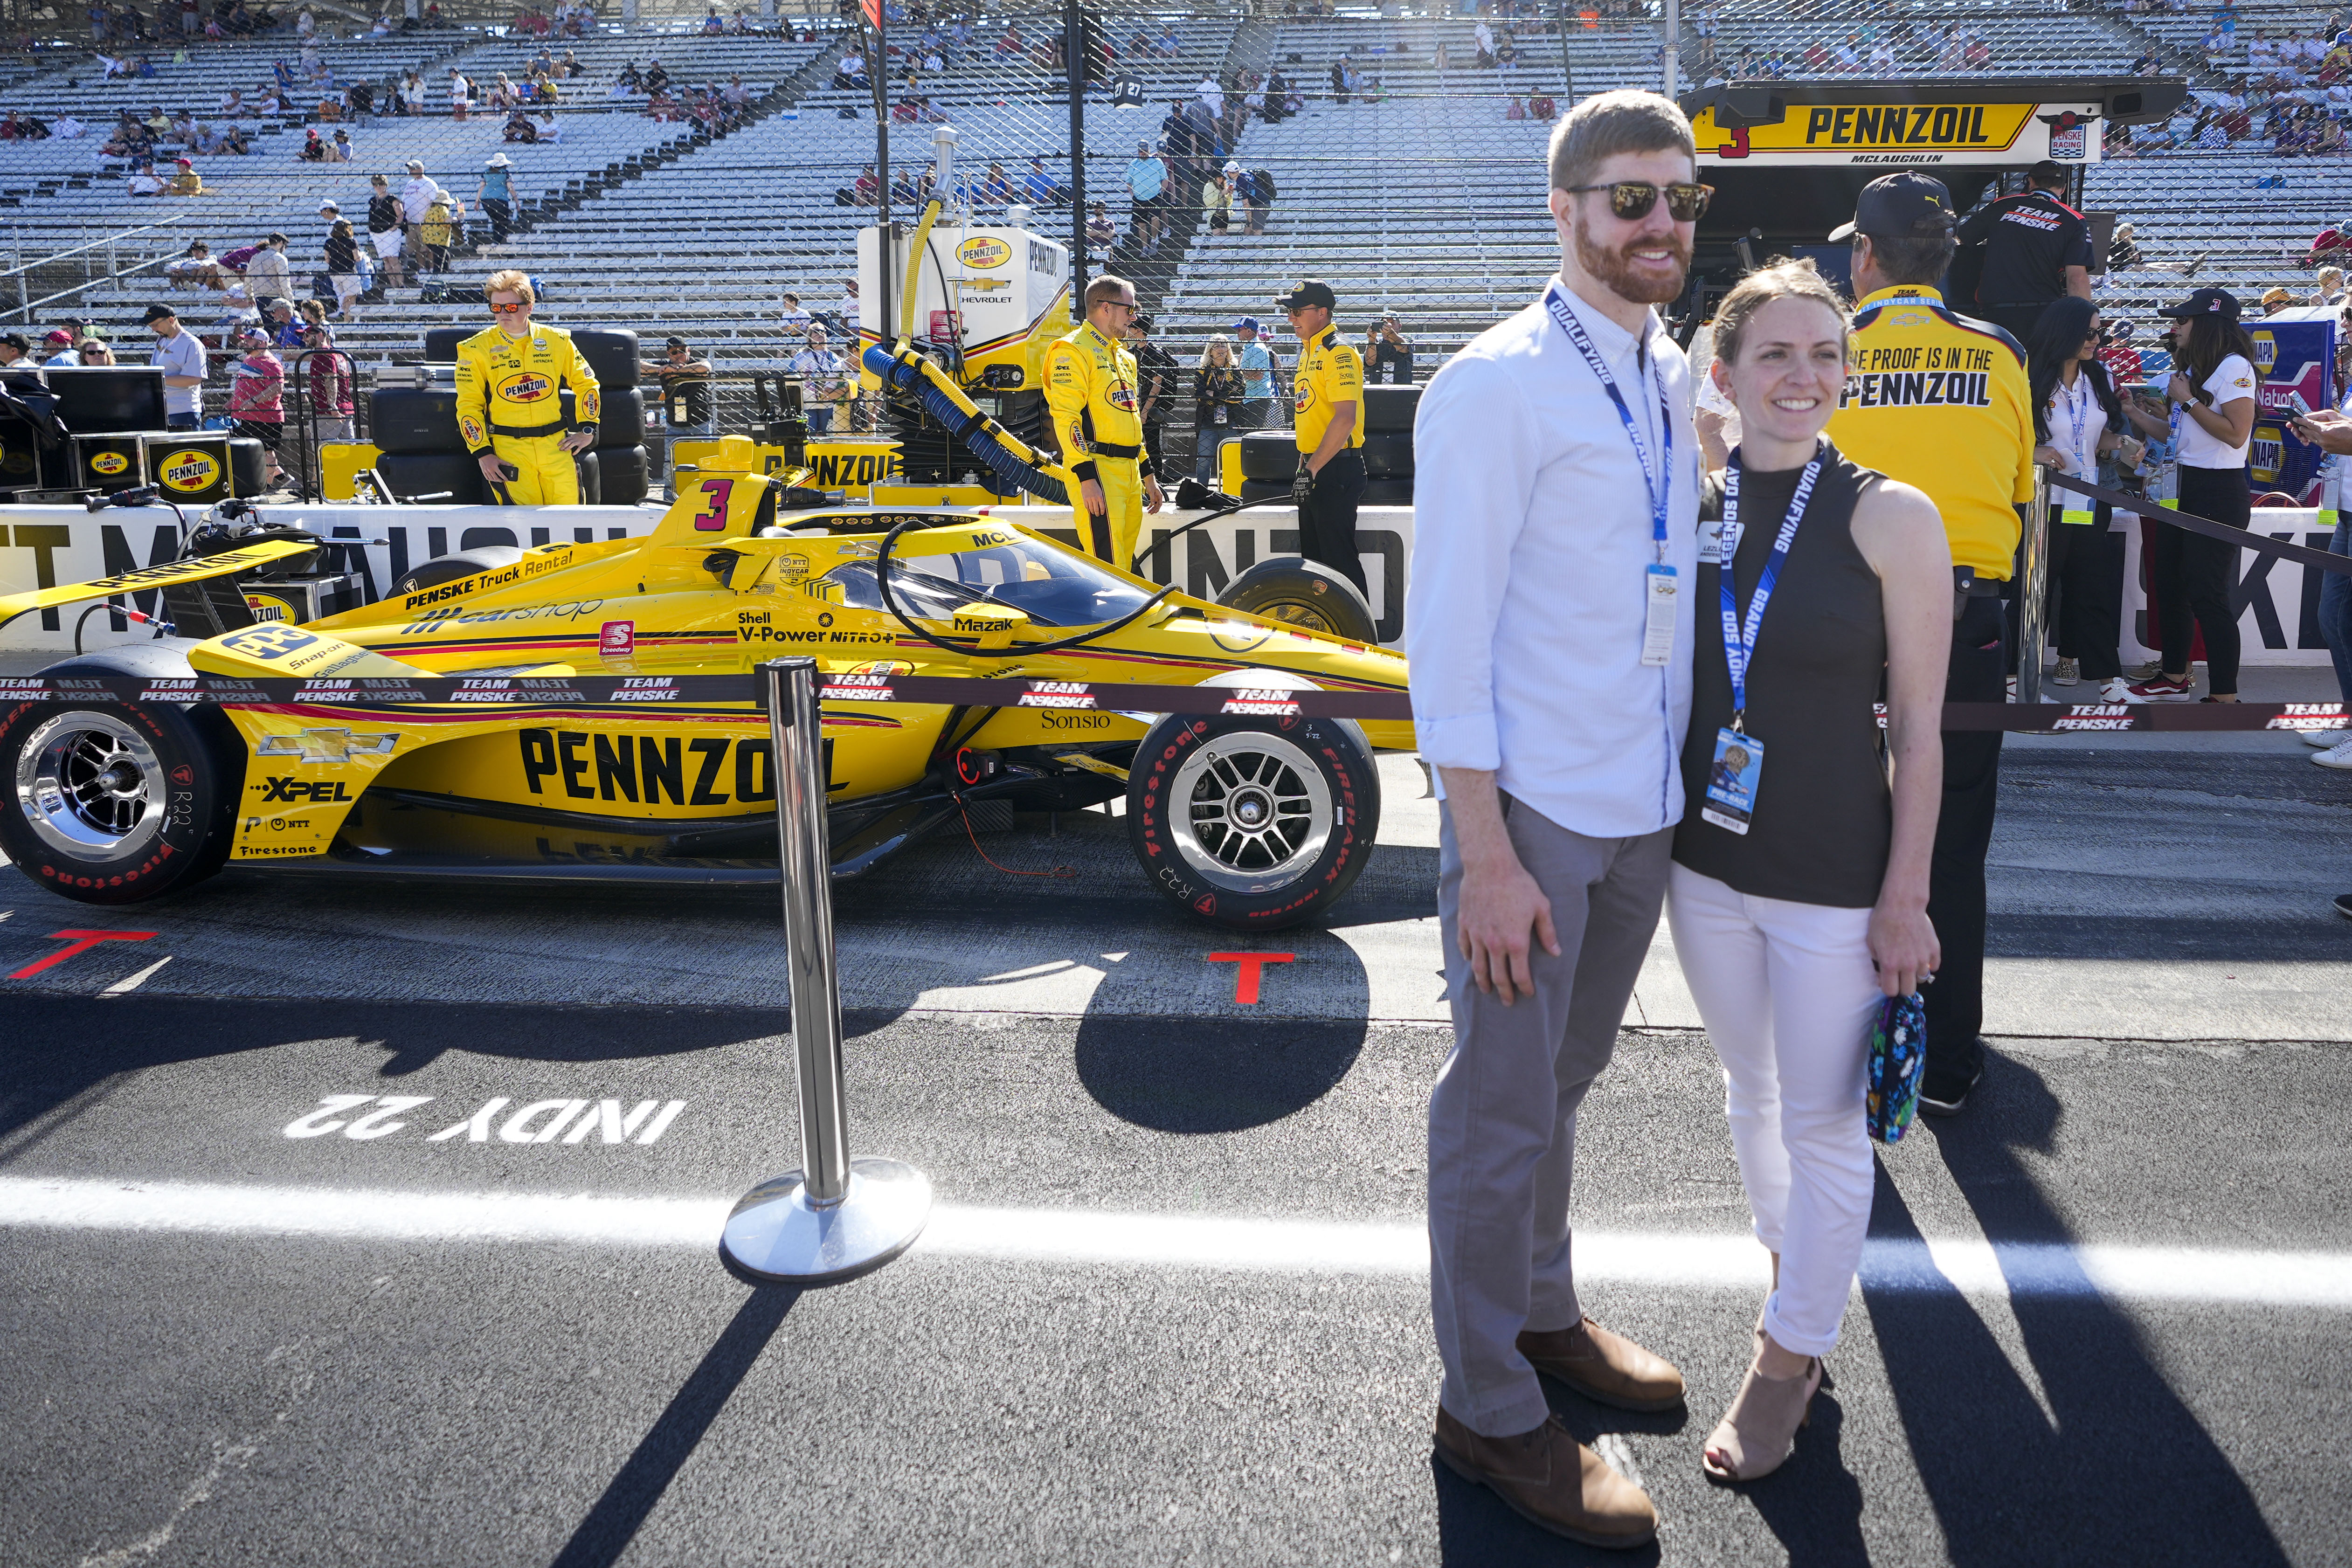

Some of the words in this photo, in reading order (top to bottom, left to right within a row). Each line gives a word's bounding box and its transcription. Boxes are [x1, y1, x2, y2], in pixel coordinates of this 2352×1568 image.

[1114, 82, 1123, 98] 27
[1128, 82, 1141, 97] 27
[1806, 107, 1988, 144] PENNZOIL
[1719, 127, 1750, 159] 3
[2053, 131, 2082, 140] PENSKE
[1850, 154, 1944, 163] MCLAUGHLIN
[1999, 212, 2060, 231] PENSKE
[2015, 205, 2060, 220] TEAM
[963, 244, 1004, 259] PENNZOIL
[1030, 240, 1058, 278] PENNZOIL
[1873, 298, 1916, 307] INDYCAR
[1089, 330, 1109, 348] PENNZOIL
[1550, 299, 1613, 385] QUALIFYING
[1871, 348, 1922, 370] PROOF
[1926, 348, 1942, 368] IS
[1946, 348, 1963, 368] IN
[1966, 349, 1994, 369] THE
[505, 379, 547, 397] PENNZOIL
[1839, 372, 1992, 408] PENNZOIL
[464, 420, 479, 442] PENNZOIL
[1072, 425, 1088, 453] PENNZOIL
[96, 459, 122, 469] PENNZOIL
[168, 462, 211, 480] PENNZOIL
[1726, 466, 1741, 496] DAY
[694, 479, 734, 532] 3
[1774, 461, 1821, 554] QUALIFYING
[1721, 499, 1739, 570] LEGENDS
[84, 552, 273, 588] PENNZOIL
[405, 580, 473, 610] PENSKE
[479, 566, 520, 589] Truck
[524, 550, 573, 577] Rental
[458, 598, 603, 624] carshop
[738, 612, 771, 624] Shell
[1743, 587, 1770, 648] GRAND
[954, 618, 1014, 632] Mazak
[1722, 611, 1741, 644] 500
[233, 628, 311, 657] PPG
[738, 626, 827, 643] V-Power
[289, 642, 346, 670] Snap-on
[1725, 646, 1744, 688] INDY
[0, 679, 45, 689] TEAM
[150, 679, 197, 689] TEAM
[304, 679, 353, 689] TEAM
[462, 679, 512, 689] TEAM
[623, 677, 674, 688] TEAM
[831, 675, 888, 686] TEAM
[1032, 681, 1089, 694] TEAM
[139, 691, 204, 701] PENSKE
[292, 691, 359, 701] PENSKE
[449, 691, 518, 701] PENSKE
[609, 690, 681, 701] PENSKE
[817, 688, 894, 700] PENSKE
[1017, 695, 1096, 708] PENSKE
[1232, 689, 1294, 702] TEAM
[1220, 702, 1301, 716] PENSKE
[2070, 705, 2128, 716] TEAM
[2283, 703, 2344, 715] TEAM
[1041, 711, 1110, 729] Sonsio
[2052, 718, 2135, 731] PENSKE
[2265, 717, 2350, 730] PENSKE
[519, 728, 851, 806] PENNZOL
[265, 777, 353, 802] XPEL
[1144, 720, 1207, 857] Firestone
[1710, 787, 1750, 807] PRE-RACE
[172, 791, 193, 826] R22
[1321, 747, 1356, 885] FIREHAWK
[288, 820, 310, 828] NTT
[239, 845, 317, 857] Firestone
[41, 842, 173, 890] Firestone
[1287, 850, 1321, 882] RACING
[1159, 864, 1197, 899] R22
[1207, 952, 1295, 1005] T
[284, 1093, 436, 1140] 22
[426, 1097, 688, 1145] INDY
